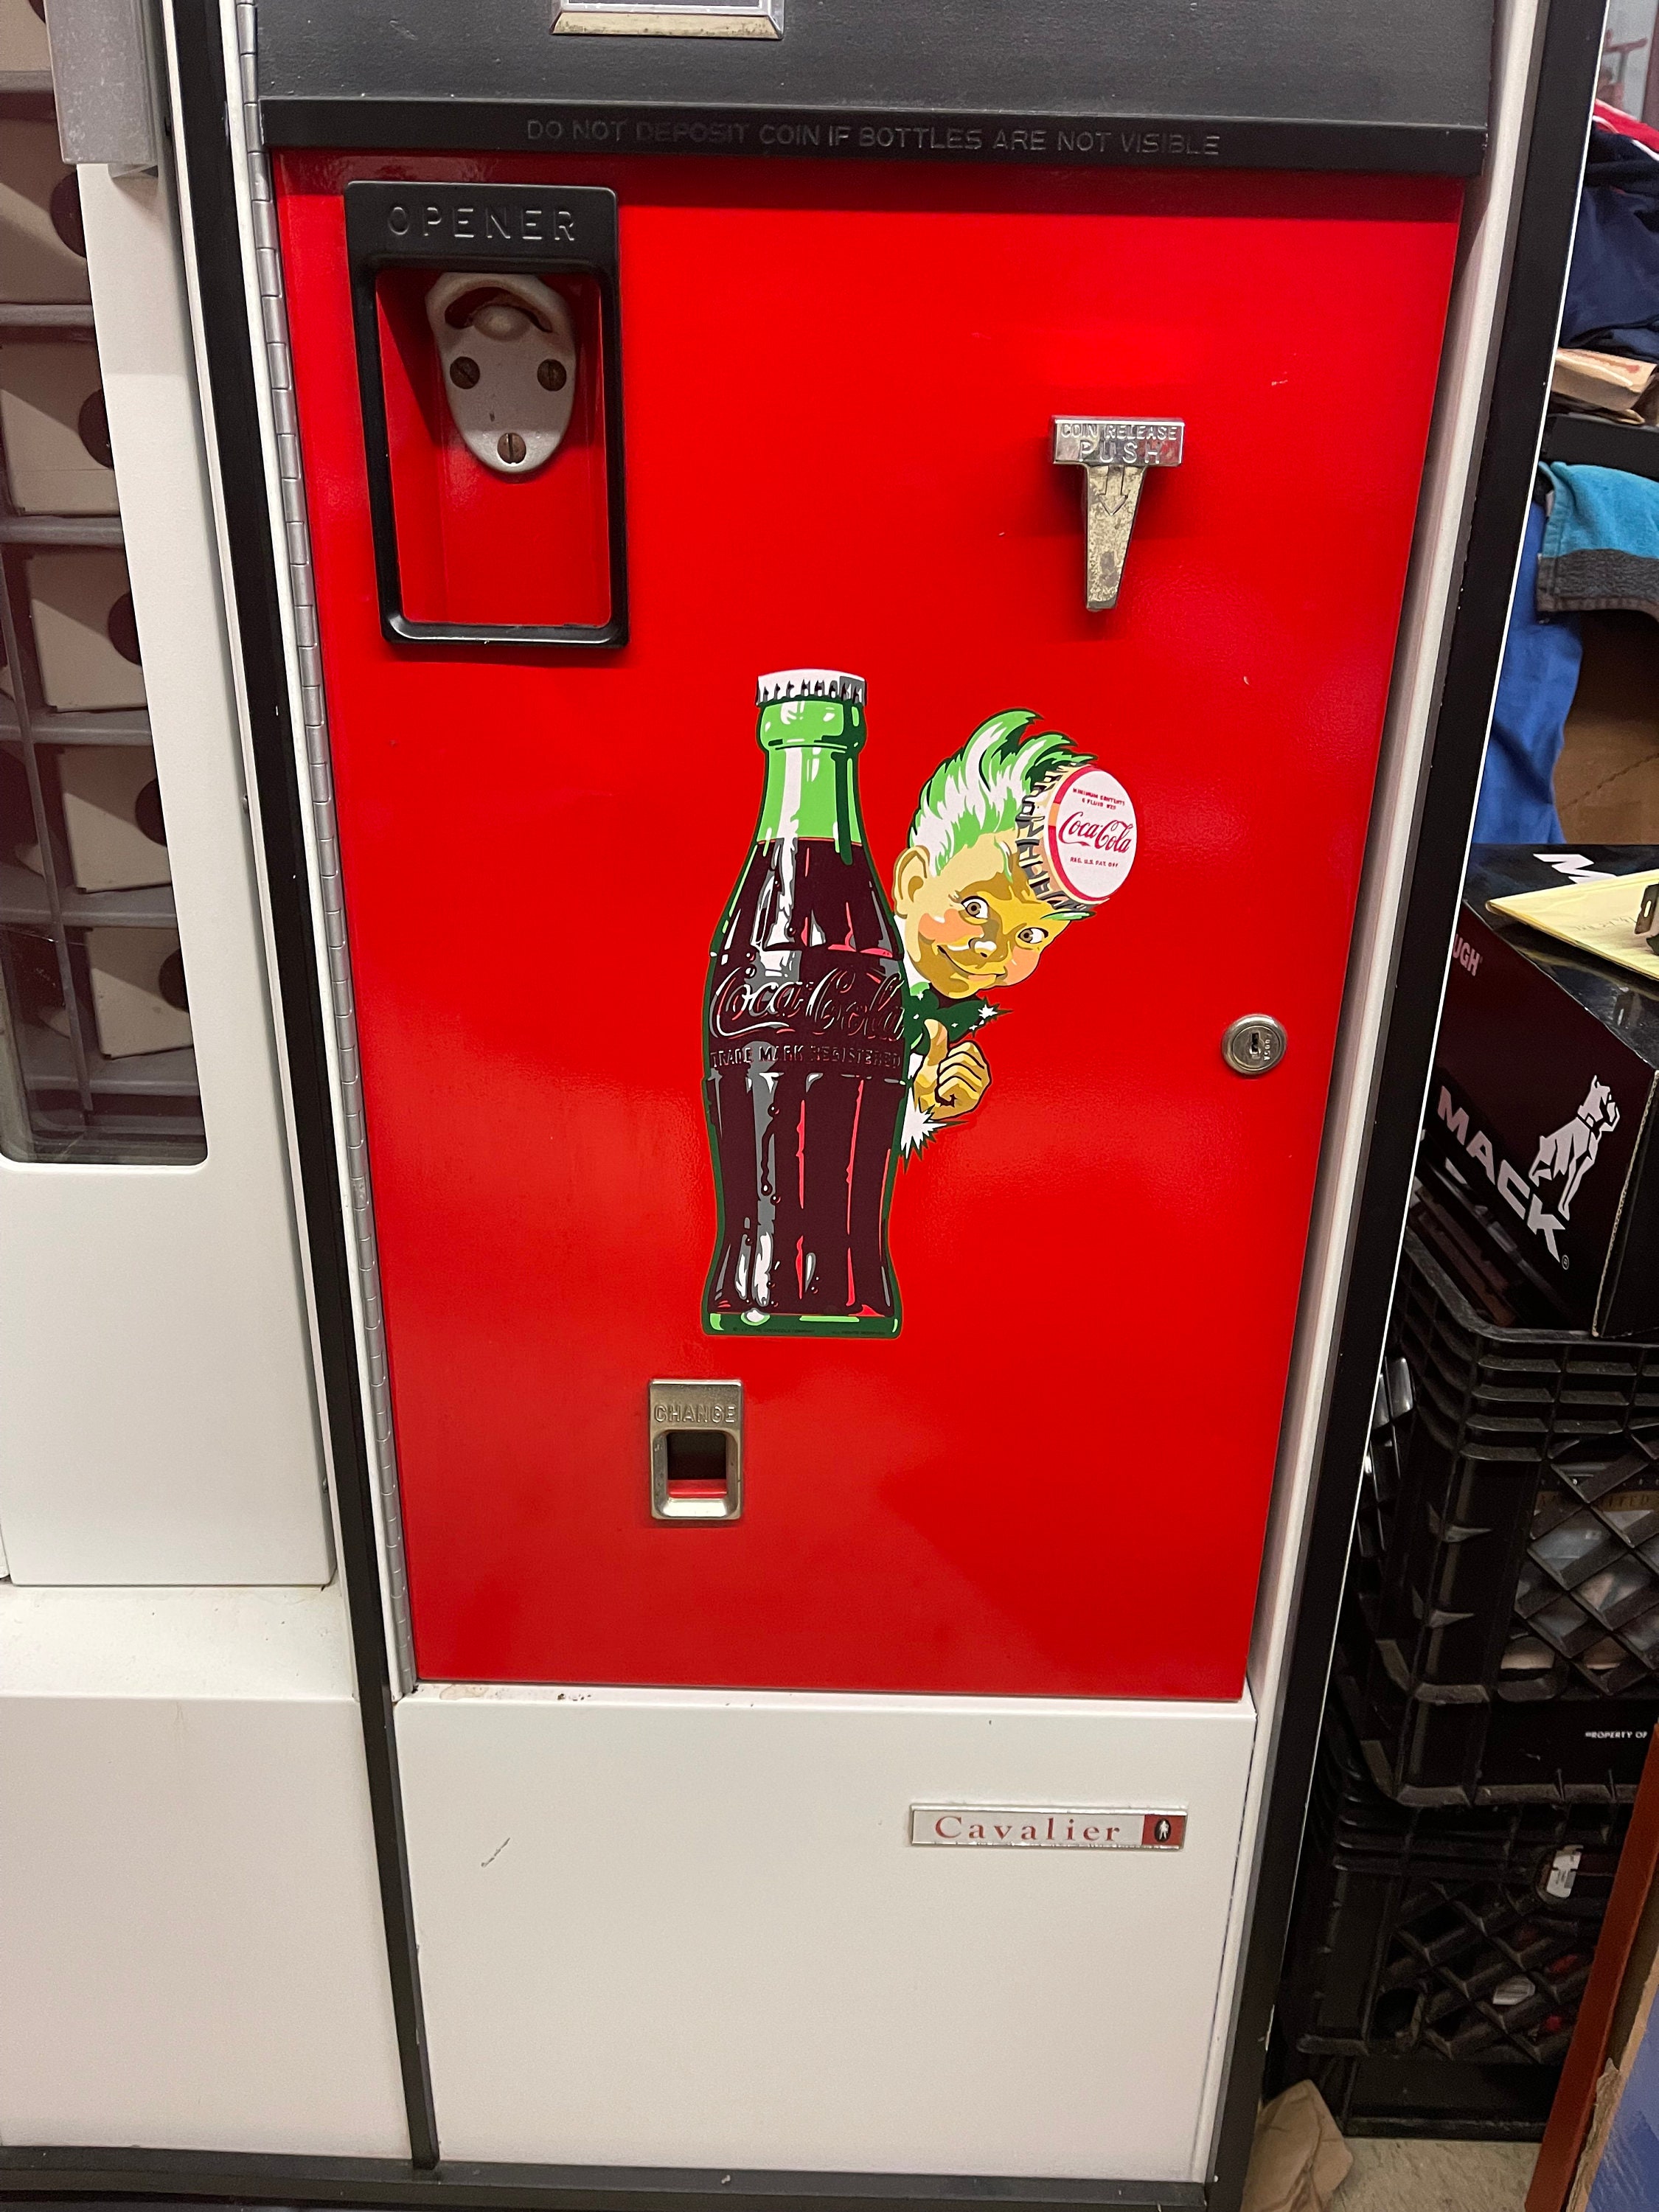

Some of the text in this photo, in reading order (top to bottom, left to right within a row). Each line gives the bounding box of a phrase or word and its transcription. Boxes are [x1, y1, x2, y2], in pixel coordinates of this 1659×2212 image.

[527, 119, 1220, 156] DO NOT DEPOSIT COIN IF BOTTLES ARE NOT VISIBLE
[387, 206, 575, 242] OPENER
[1060, 423, 1178, 441] COIN RELEASE
[1079, 439, 1164, 465] PUSH
[710, 1045, 902, 1068] TRADE MARK REGISTERED
[1438, 1085, 1566, 1263] MACK
[654, 1403, 737, 1424] CHANGE
[934, 1815, 1121, 1842] Cavalier
